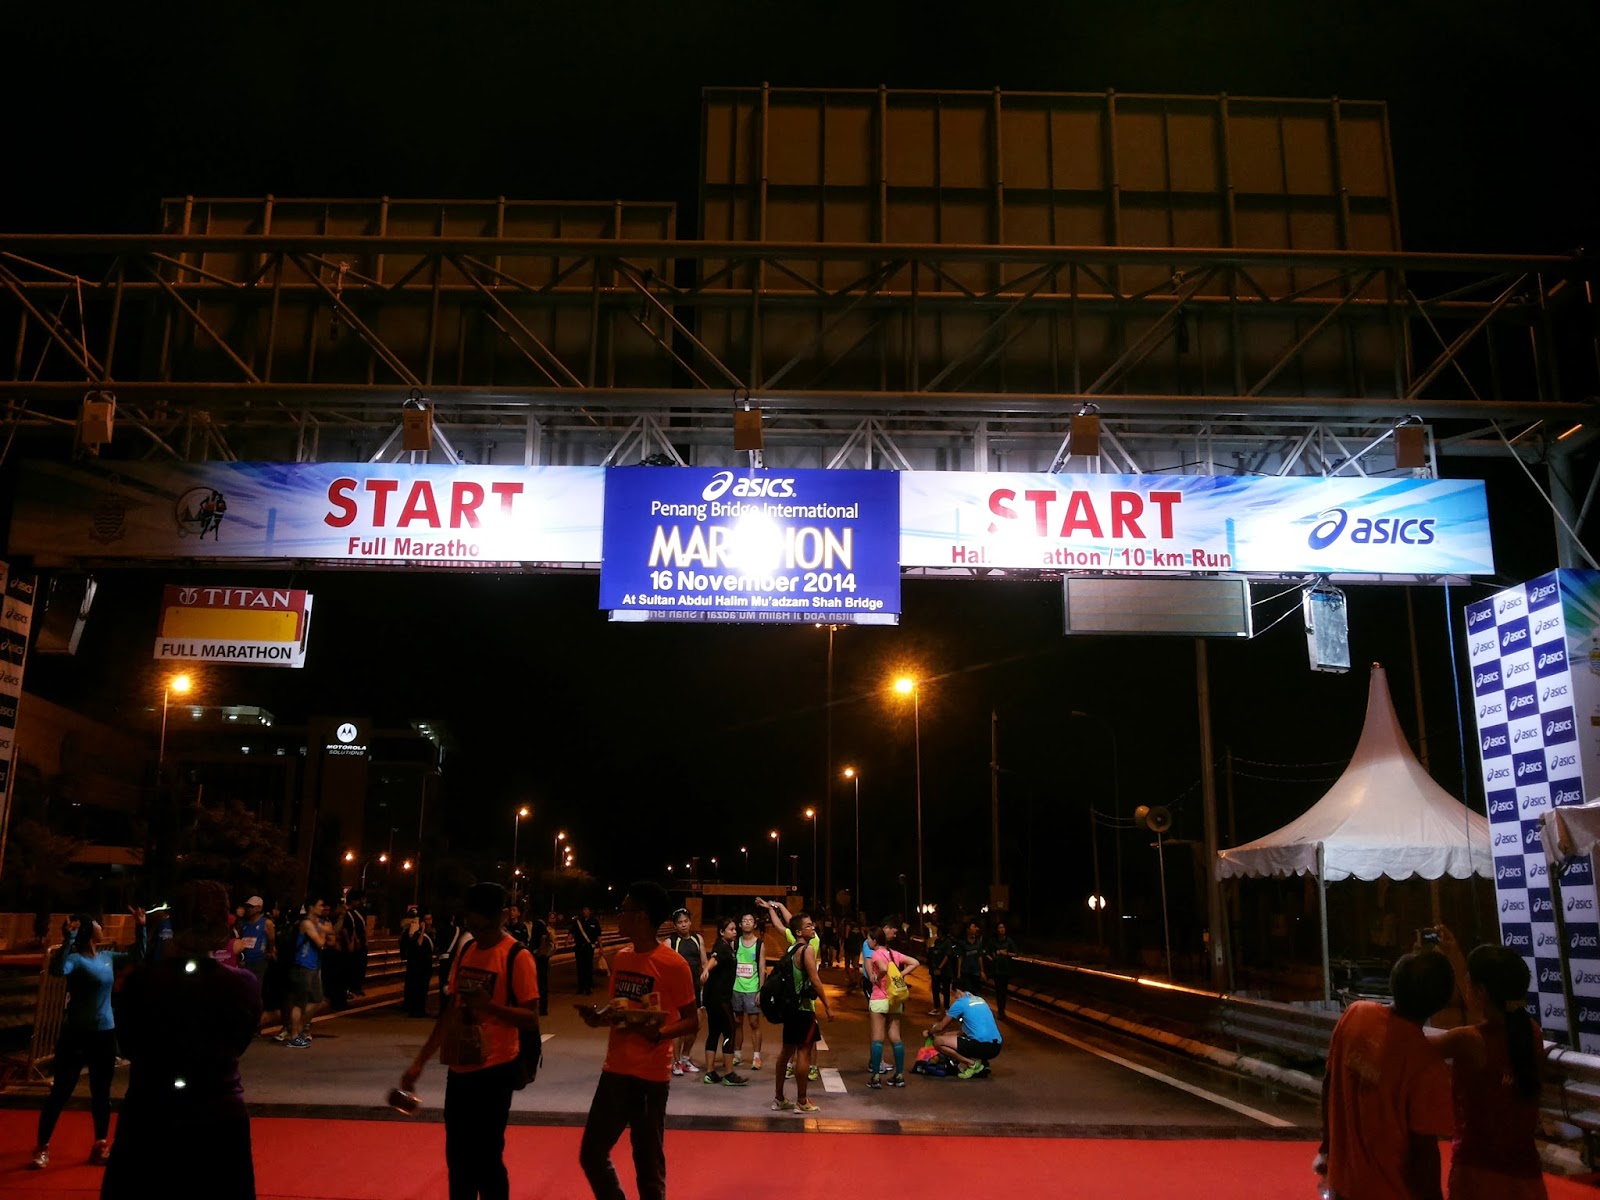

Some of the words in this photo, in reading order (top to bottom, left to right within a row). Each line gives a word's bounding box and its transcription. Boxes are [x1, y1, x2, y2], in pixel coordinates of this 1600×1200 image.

[732, 478, 795, 497] asics
[323, 478, 524, 529] START
[651, 501, 707, 521] Penang
[763, 502, 859, 519] International
[987, 488, 1182, 540] START
[1351, 518, 1435, 544] asics
[348, 537, 386, 555] Full
[394, 538, 480, 557] Maratho
[952, 546, 992, 564] Hal
[1043, 548, 1101, 566] athon
[1121, 548, 1146, 566] 10
[1153, 549, 1185, 567] km
[1192, 549, 1232, 568] Run
[650, 570, 673, 591] 16
[678, 571, 799, 592] November
[804, 572, 857, 592] 2014
[1538, 583, 1556, 598] asics
[203, 588, 291, 608] TITAN
[622, 594, 636, 605] At
[638, 594, 676, 606] Sultan
[678, 595, 712, 606] Abdul
[715, 595, 748, 607] Halim
[751, 596, 809, 608] Mu'adzam
[812, 596, 842, 608] Shah
[845, 597, 884, 609] Bridge
[1506, 597, 1522, 609] asics
[1476, 608, 1492, 620] asics
[1543, 616, 1559, 630] asics
[1509, 628, 1526, 642] asics
[162, 644, 198, 657] FULL
[201, 644, 292, 660] MARATHON
[1479, 640, 1495, 652] asics
[1546, 650, 1564, 664] asics
[1513, 662, 1530, 674] asics
[1483, 671, 1499, 683] asics
[1550, 684, 1568, 697] asics
[1517, 694, 1534, 707] asics
[1486, 704, 1502, 715] asics
[1554, 720, 1572, 732] asics
[1490, 735, 1506, 746] asics
[1522, 728, 1538, 740] asics
[1525, 761, 1542, 773] asics
[1558, 755, 1576, 766] asics
[1494, 768, 1510, 778] asics
[1530, 796, 1546, 806] asics
[1563, 790, 1580, 802] asics
[1498, 801, 1514, 812] asics
